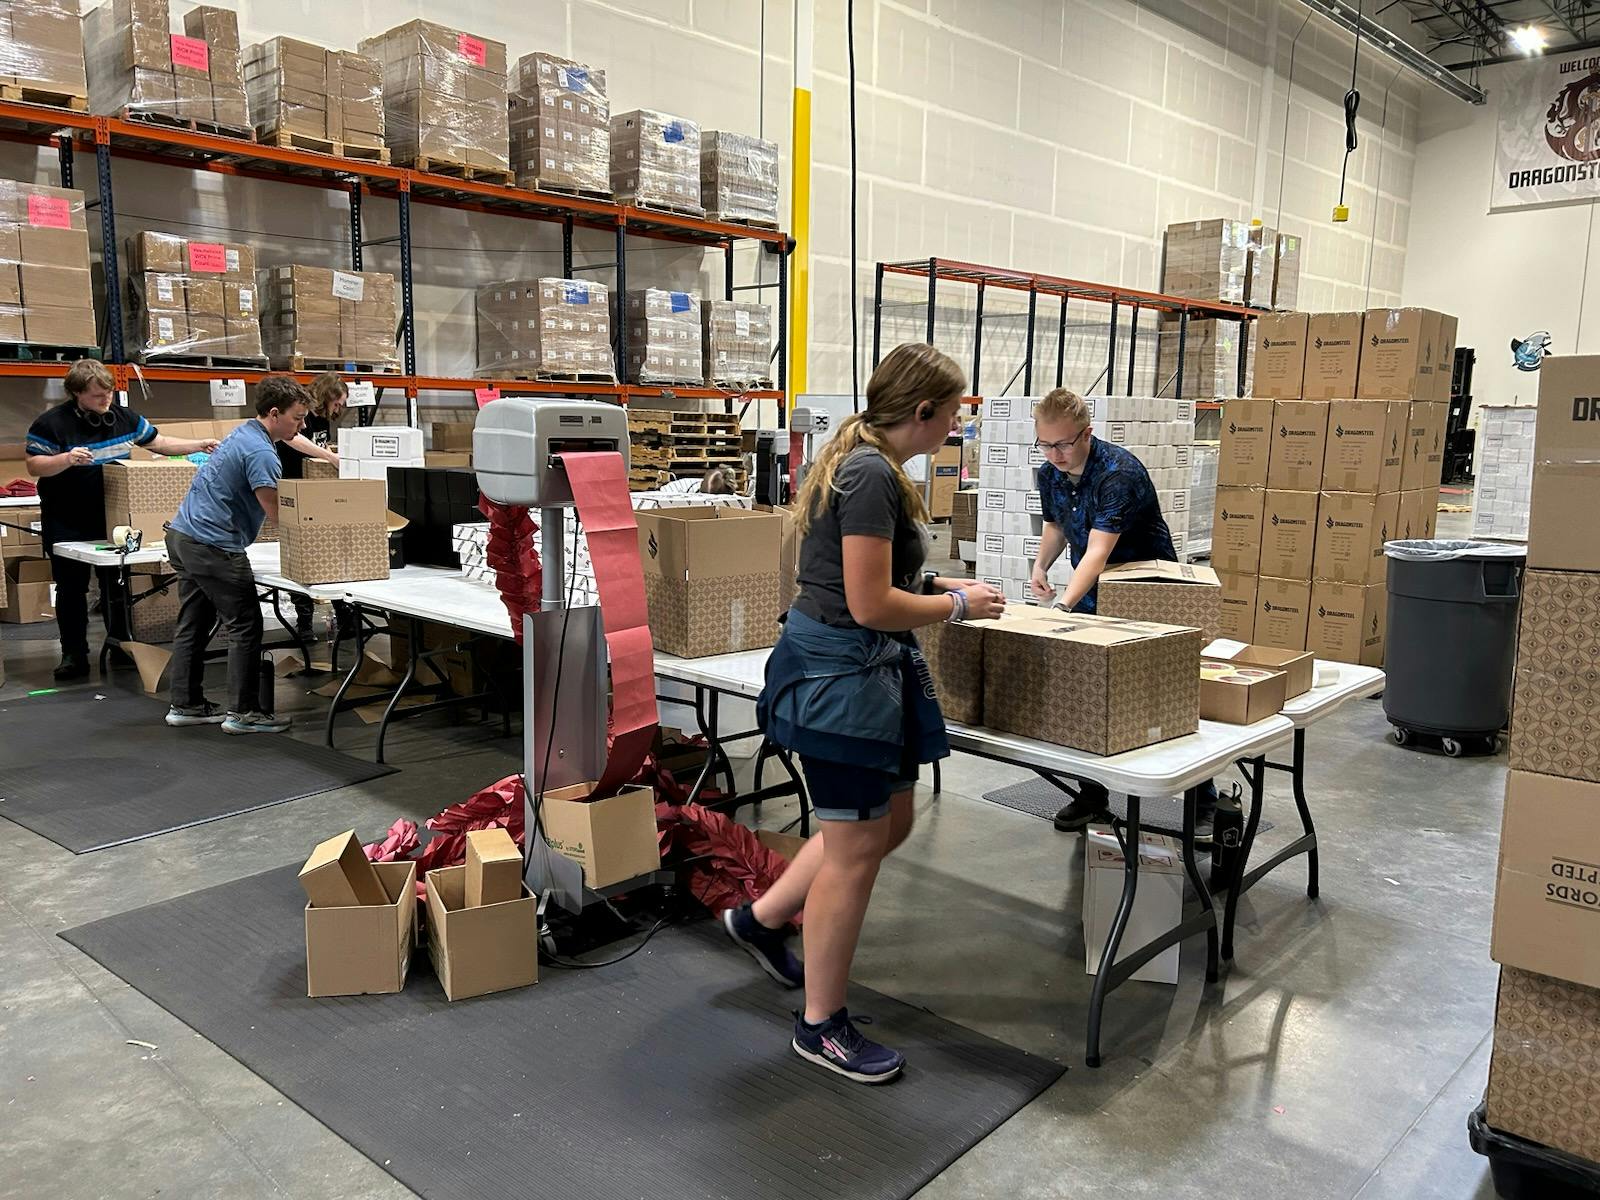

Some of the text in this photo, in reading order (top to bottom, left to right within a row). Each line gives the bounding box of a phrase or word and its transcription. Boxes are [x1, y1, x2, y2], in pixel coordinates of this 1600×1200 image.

[1509, 161, 1600, 188] DRAGONST
[1572, 397, 1600, 421] DR
[1551, 863, 1600, 885] PTED
[1546, 883, 1600, 906] ORDS
